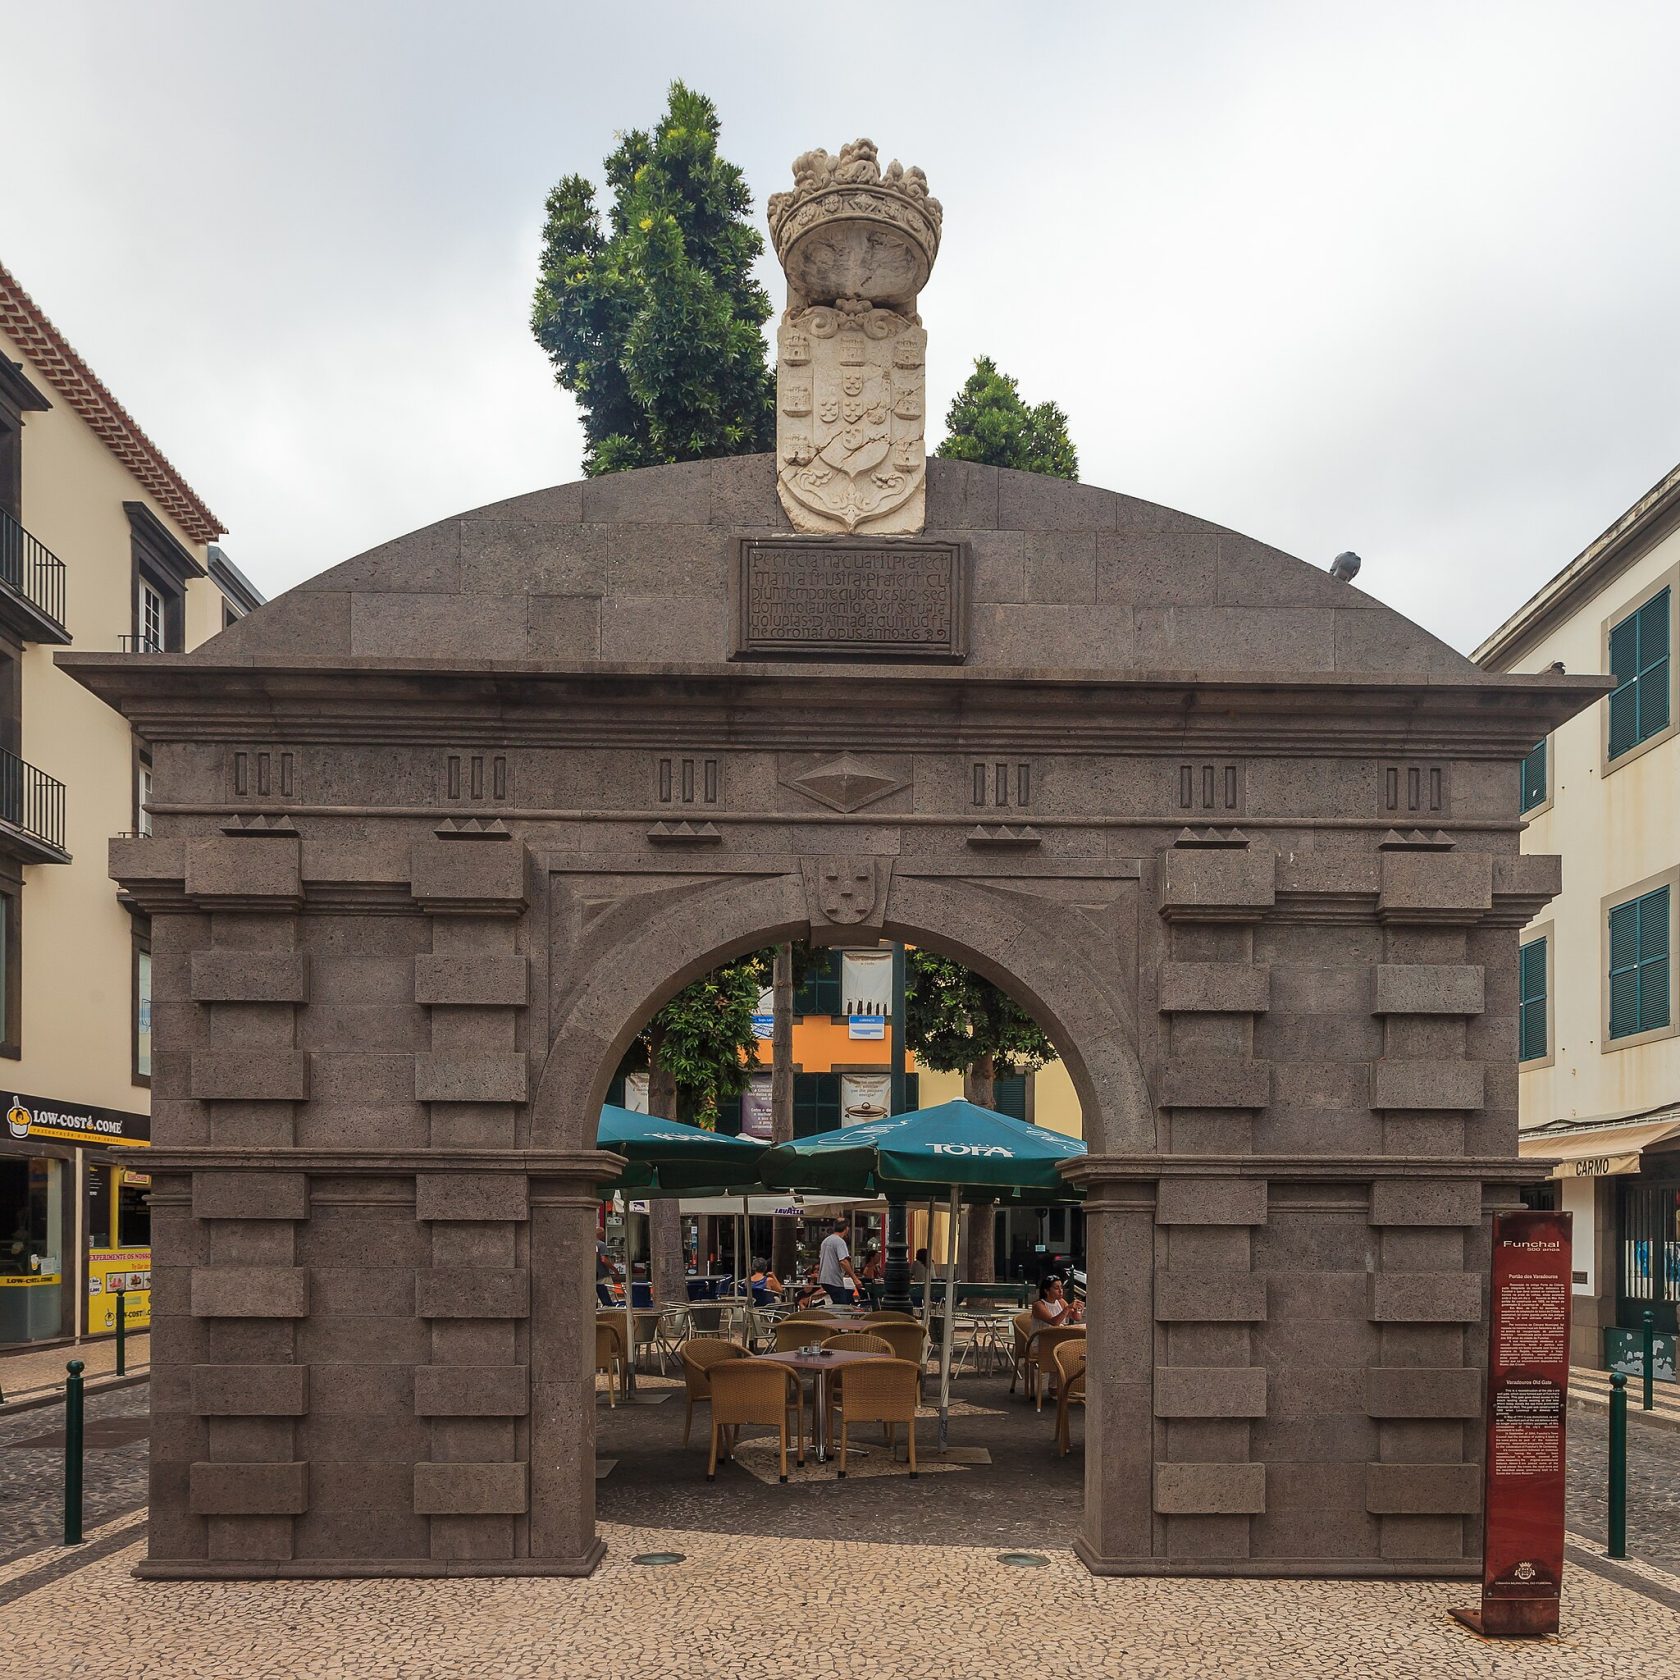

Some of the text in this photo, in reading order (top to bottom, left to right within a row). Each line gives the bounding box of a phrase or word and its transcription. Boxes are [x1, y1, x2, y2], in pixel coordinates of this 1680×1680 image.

[925, 1143, 1014, 1158] TOFA
[1576, 1159, 1609, 1176] CARMO
[774, 1206, 805, 1215] LAVAZZA
[1503, 1240, 1560, 1248] Funchal
